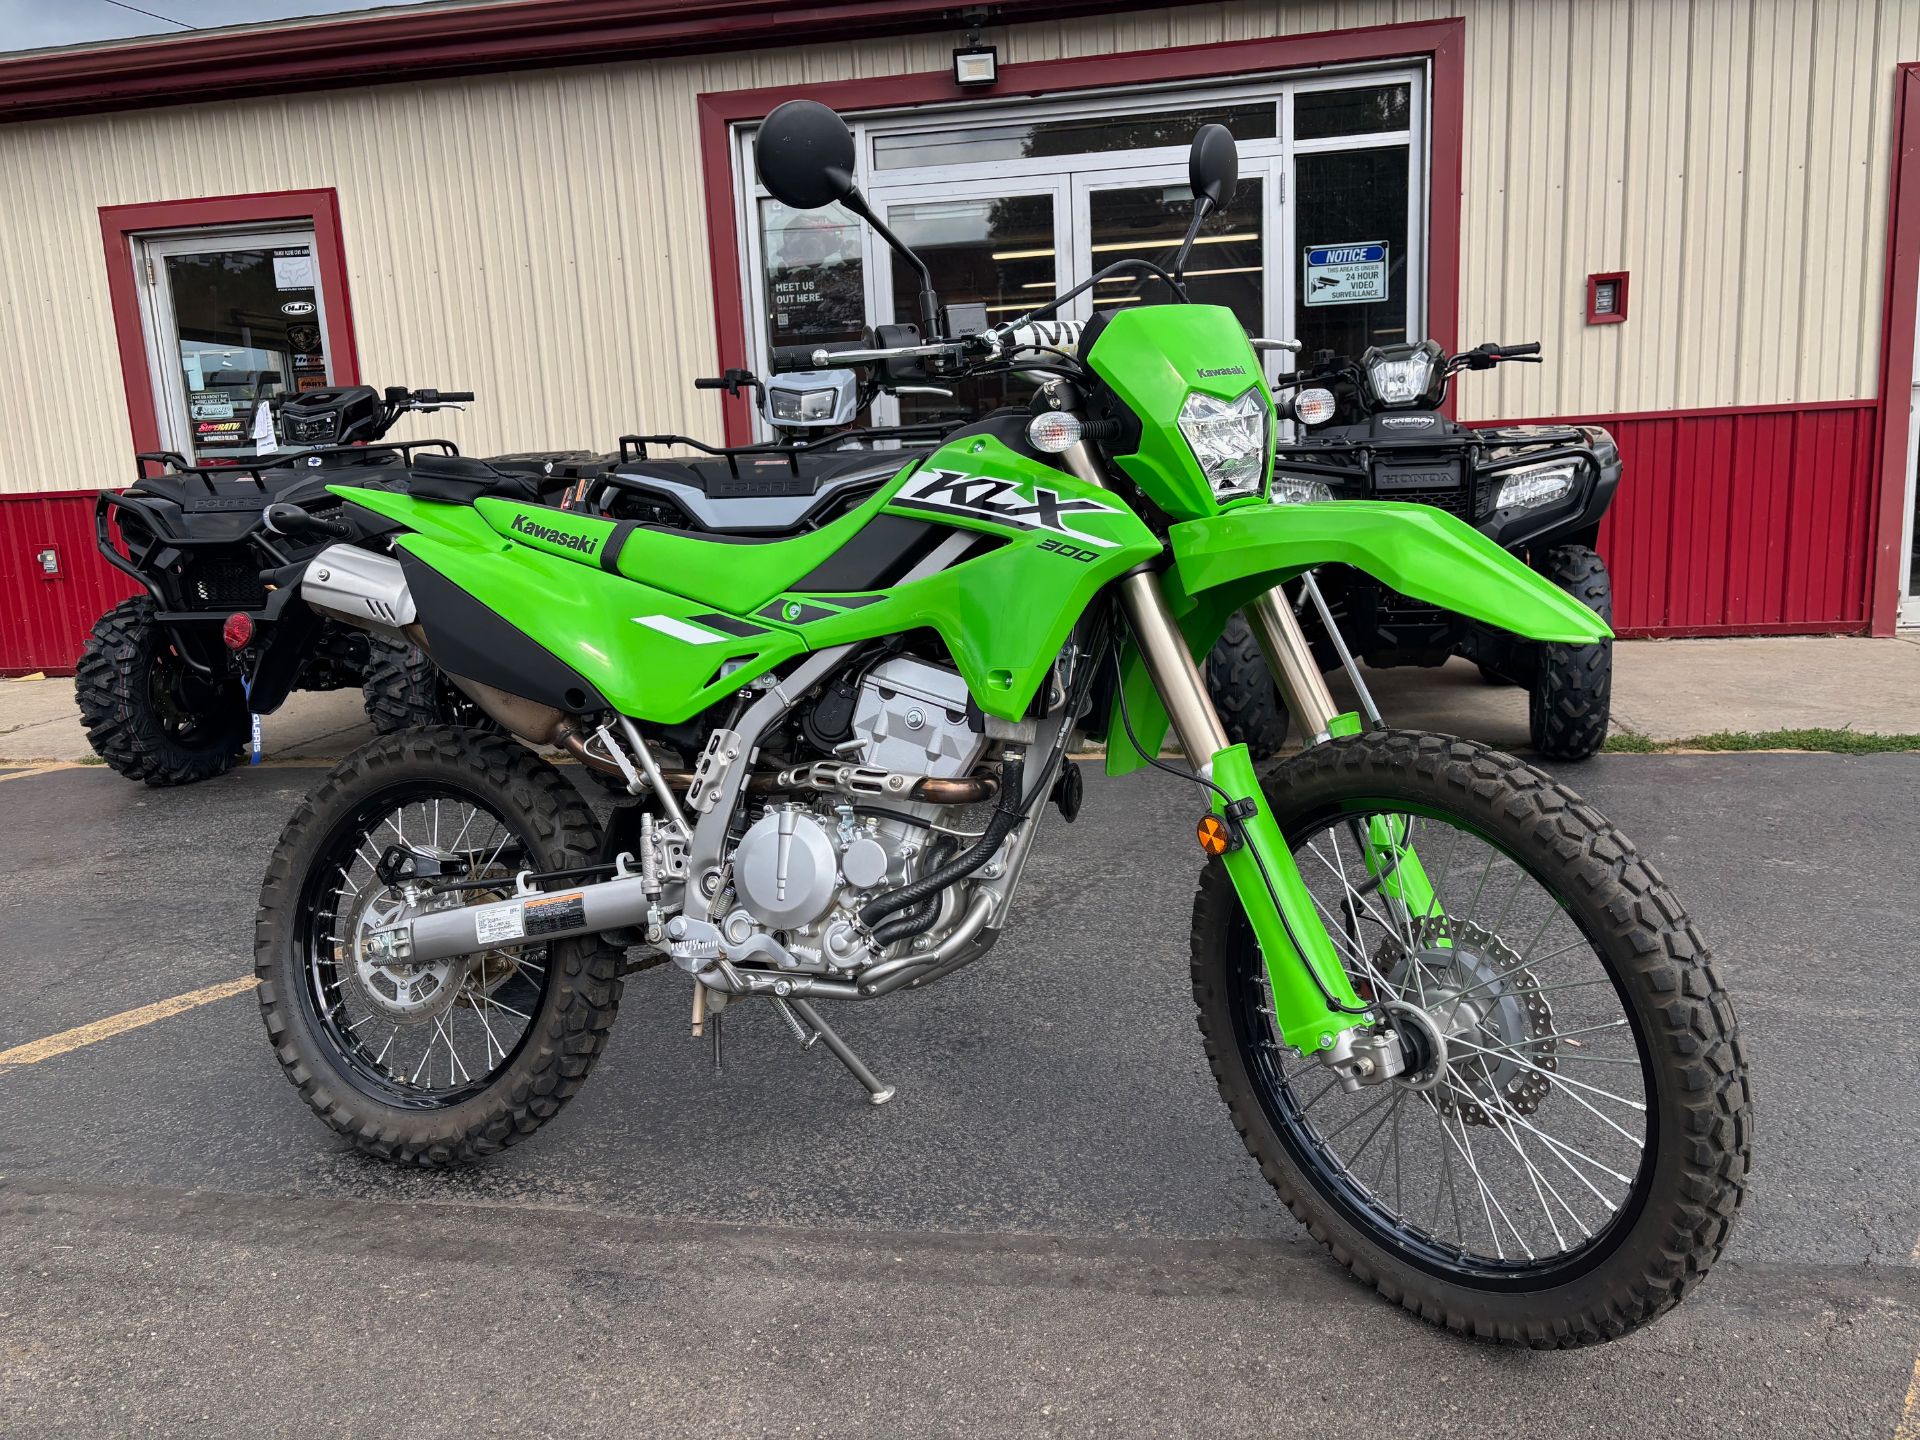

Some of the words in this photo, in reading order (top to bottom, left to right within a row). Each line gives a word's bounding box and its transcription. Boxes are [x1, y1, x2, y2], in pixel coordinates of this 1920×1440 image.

[1326, 248, 1368, 263] NOTICE
[1358, 271, 1379, 280] HOUR
[775, 282, 800, 292] MEET
[802, 281, 815, 290] US
[1351, 281, 1374, 289] VIDEO
[777, 294, 795, 304] OUT
[797, 293, 824, 303] HERE.
[1331, 290, 1378, 299] SURVEILLANCE
[1196, 365, 1246, 379] Kawasaki
[1382, 416, 1435, 425] FOREMAN
[1382, 472, 1454, 484] HONDA
[195, 497, 262, 509] POLARIS
[909, 470, 1110, 534] KLX
[510, 513, 599, 555] Kawasaki
[1036, 538, 1101, 563] 300
